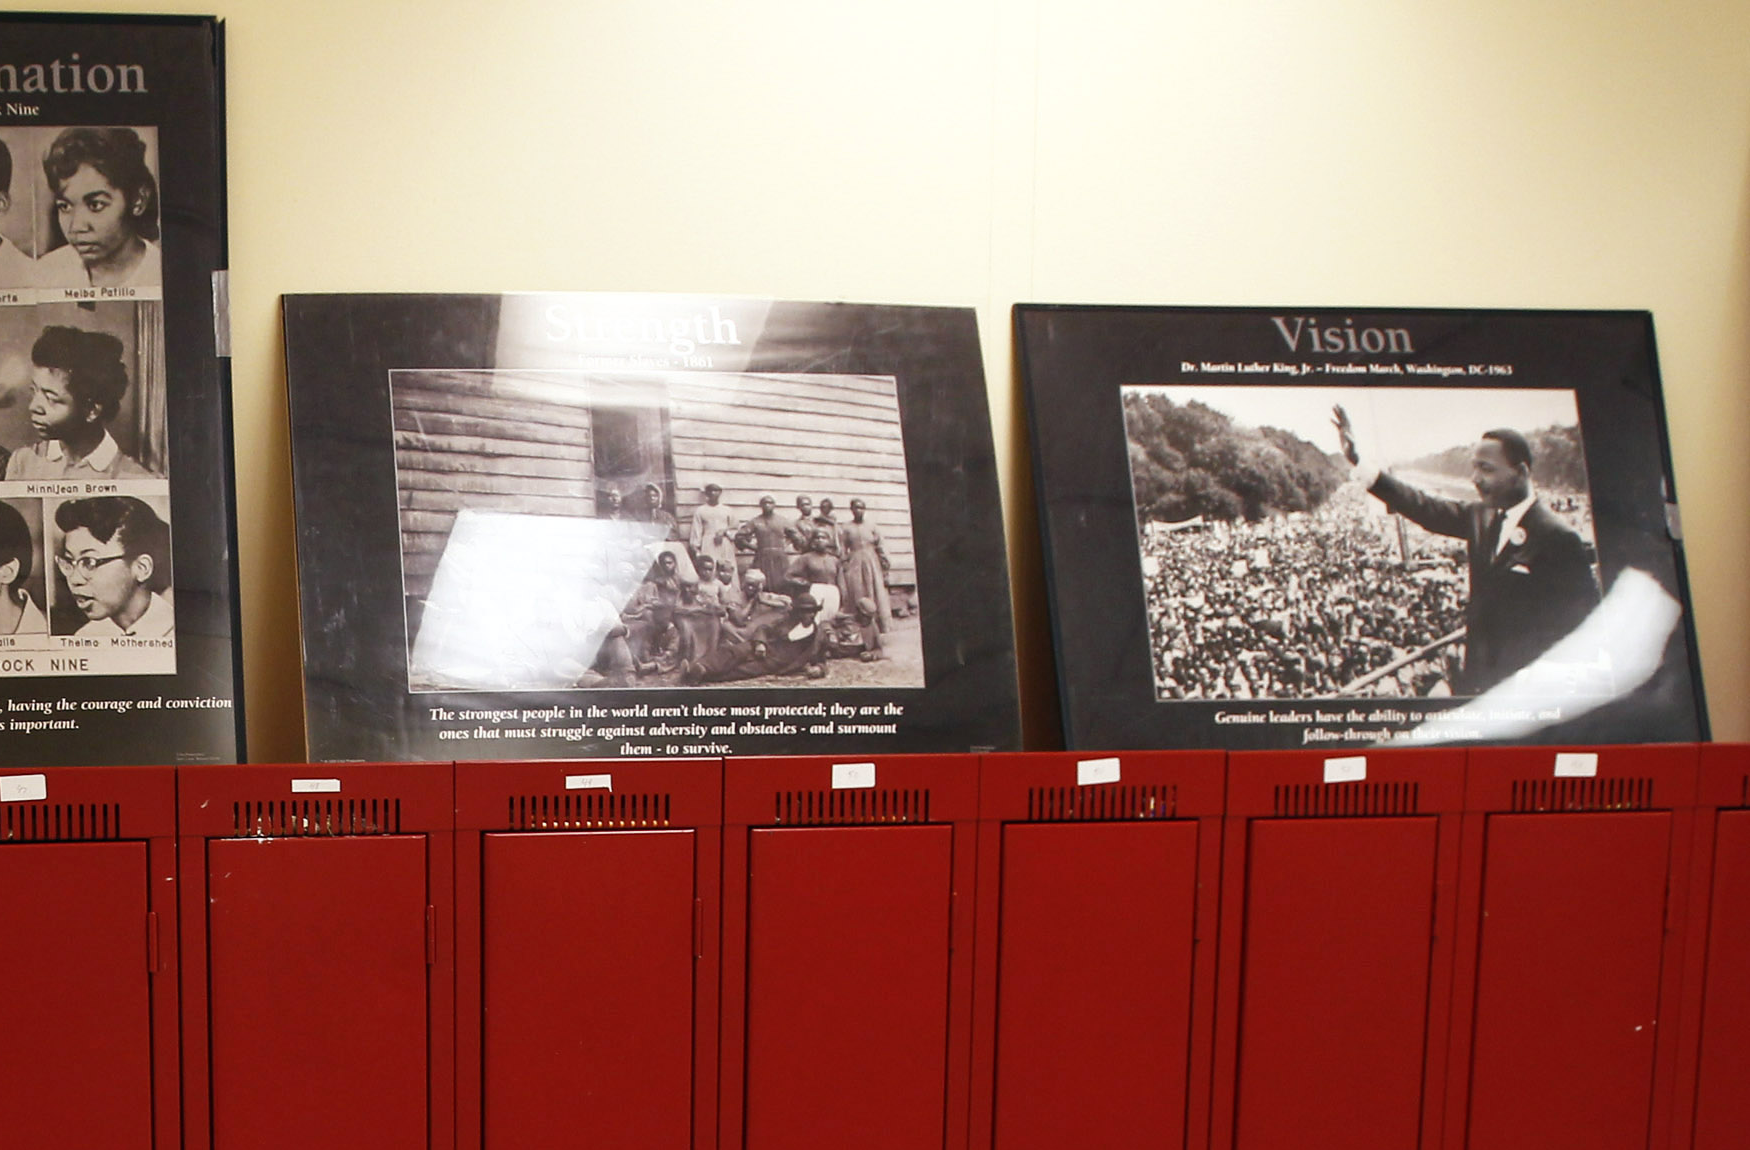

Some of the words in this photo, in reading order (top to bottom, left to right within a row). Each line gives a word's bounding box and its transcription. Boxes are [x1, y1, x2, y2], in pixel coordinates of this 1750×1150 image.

[7, 102, 39, 116] Nine
[65, 289, 95, 298] Melba
[545, 304, 742, 356] Strength
[1271, 316, 1415, 353] Vision
[683, 354, 714, 368] 1861
[1180, 361, 1199, 373] Dr.
[1200, 361, 1236, 373] Martin
[1237, 361, 1271, 373] Luther
[1325, 362, 1368, 373] Freedom
[85, 484, 117, 493] Brown
[60, 637, 100, 648] Thelma
[111, 638, 174, 648] Mothershed
[50, 659, 89, 672] NINE
[7, 699, 52, 715] having
[56, 698, 78, 711] the
[81, 701, 133, 714] courage
[136, 697, 162, 710] and
[165, 696, 233, 709] conviction
[429, 707, 455, 721] The
[458, 707, 518, 723] strongest
[522, 705, 566, 723] people
[569, 706, 583, 718] in
[587, 705, 608, 718] the
[611, 704, 648, 718] world
[651, 704, 689, 717] aren't
[692, 703, 727, 717] those
[730, 704, 761, 717] most
[764, 702, 827, 720] protected;
[830, 702, 857, 719] they
[860, 705, 881, 716] are
[883, 702, 904, 716] the
[1214, 711, 1267, 724] Genuine
[1268, 709, 1313, 724] leaders
[1315, 709, 1344, 723] have
[1346, 709, 1366, 722] the
[1368, 708, 1407, 725] ability
[1410, 710, 1423, 722] to
[9, 718, 80, 734] important.
[439, 729, 470, 740] ones
[473, 726, 501, 739] that
[504, 727, 537, 739] must
[540, 724, 594, 742] struggle
[597, 725, 645, 741] against
[649, 722, 708, 739] adversity
[710, 722, 736, 736] and
[739, 721, 797, 735] obstacles
[809, 721, 835, 735] and
[837, 722, 897, 735] surmount
[1302, 727, 1392, 745] follow-through
[1394, 729, 1410, 740] on
[620, 742, 653, 756] them
[665, 743, 680, 755] to
[682, 742, 733, 755] survive.
